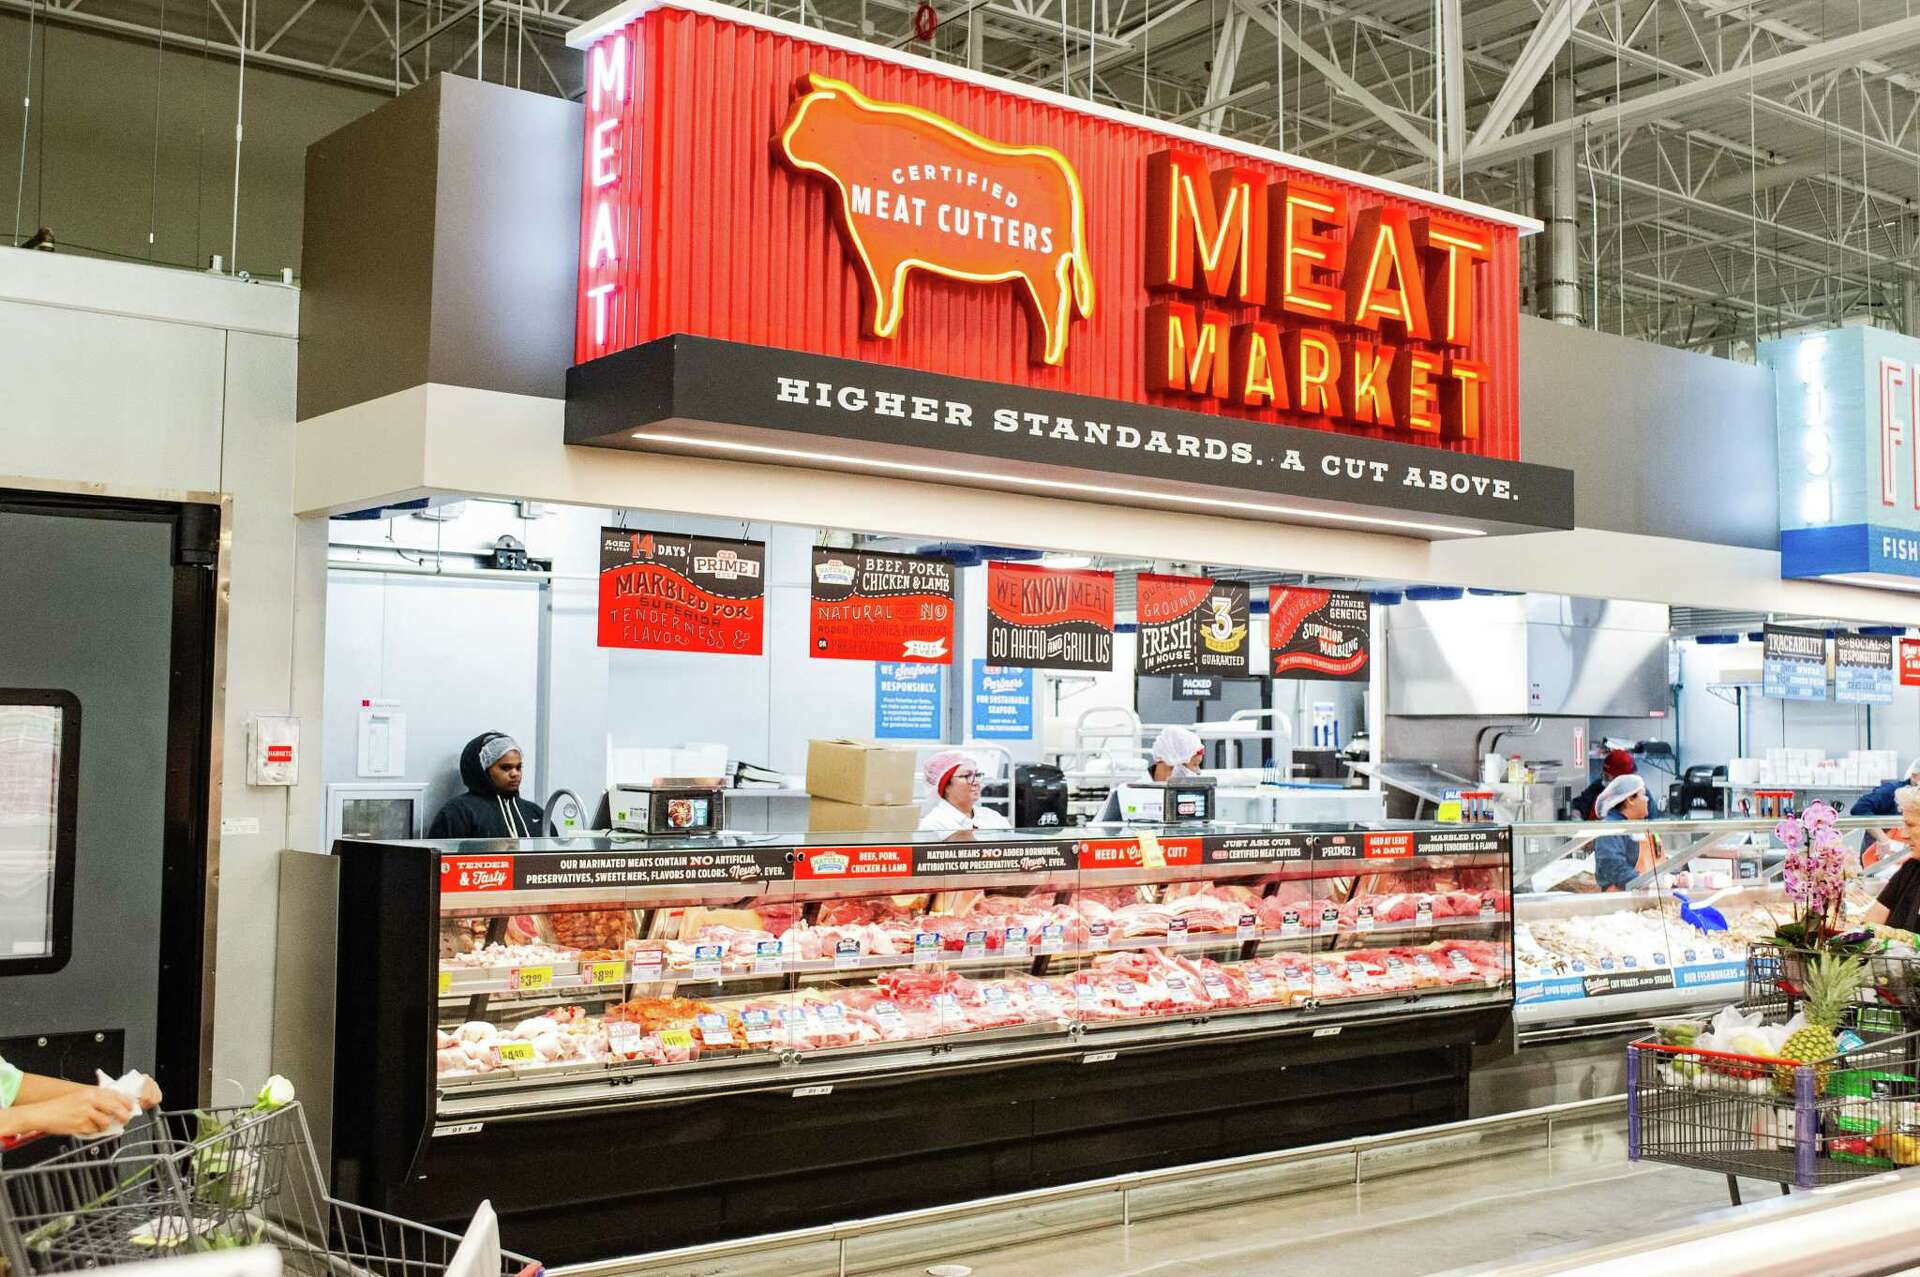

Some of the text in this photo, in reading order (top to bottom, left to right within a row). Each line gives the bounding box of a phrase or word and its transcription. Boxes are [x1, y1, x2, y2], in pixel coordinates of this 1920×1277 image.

[588, 35, 627, 346] MEAT
[892, 164, 1018, 208] CERTIFIED
[851, 184, 1054, 254] MEAT CUTTERS
[1148, 150, 1493, 348] MEAT
[1146, 302, 1489, 440] MARKET
[777, 377, 1519, 501] HIGHER STANDARDS. A CUT ABOVE.
[605, 532, 686, 559] AGED 14 DAYS
[696, 558, 748, 574] PRIME
[865, 558, 904, 574] BEEF,
[908, 561, 949, 578] PORK,
[862, 572, 910, 591] CHICKEN
[921, 577, 950, 592] LAMB
[615, 571, 753, 621] MARBLED FOR
[996, 575, 1109, 616] WE KNOW MEAT
[1144, 590, 1197, 617] GROUND
[639, 597, 721, 626] SUPERIOR
[818, 602, 947, 624] NATURAL NO
[1211, 596, 1233, 640] 3
[1329, 608, 1368, 621] GENETICS
[610, 607, 726, 649] TENDERNESS
[623, 624, 690, 646] FLAVOR
[1302, 623, 1344, 643] SUPERIOR
[992, 627, 1008, 658] GO
[1011, 628, 1047, 660] AHEAD
[1063, 631, 1094, 663] GRILL
[1096, 634, 1110, 664] US
[1141, 618, 1193, 659] FRESH
[1320, 637, 1359, 658] MARBLING
[1767, 633, 1823, 655] TRACEABILITY
[1850, 638, 1879, 650] SOCIAL
[1145, 650, 1192, 670] IN HOUSE
[1201, 654, 1245, 666] GUARANTEED
[1838, 649, 1890, 664] RESPONSIBILITY
[1223, 838, 1291, 848] JUST ASK OUR
[1418, 843, 1444, 853] SUPERIOR
[1444, 842, 1474, 852] TENDERNESS
[1479, 841, 1498, 850] FLAVOR
[1430, 833, 1487, 842] MARBLED FOR
[560, 854, 755, 870] OUR MARINATED MEATS CONTAIN NO ARTIFICIAL
[927, 850, 957, 860] NATURAL
[958, 849, 980, 858] MEANS
[981, 848, 1002, 858] NO
[1003, 848, 1024, 857] ADDED
[1094, 848, 1117, 860] NEED
[1118, 847, 1125, 859] A
[1167, 846, 1188, 858] CUT?
[1229, 848, 1259, 859] CERTIFIED
[1259, 848, 1275, 858] MEAT
[1276, 847, 1301, 857] CUTTERS
[1321, 846, 1351, 858] PRIME
[456, 861, 509, 870] TENDER
[526, 873, 594, 884] PRESERVATIVES,
[651, 870, 684, 880] FLAVORS
[685, 869, 697, 879] OR
[698, 868, 728, 878] COLORS.
[764, 866, 785, 876] EVER.
[851, 864, 880, 873] CHICKEN
[888, 863, 907, 872] LAMB
[917, 861, 959, 872] ANTIBIOTICS
[959, 861, 969, 870] OR
[1048, 858, 1067, 867] EVER.
[459, 870, 506, 886] & Tasty
